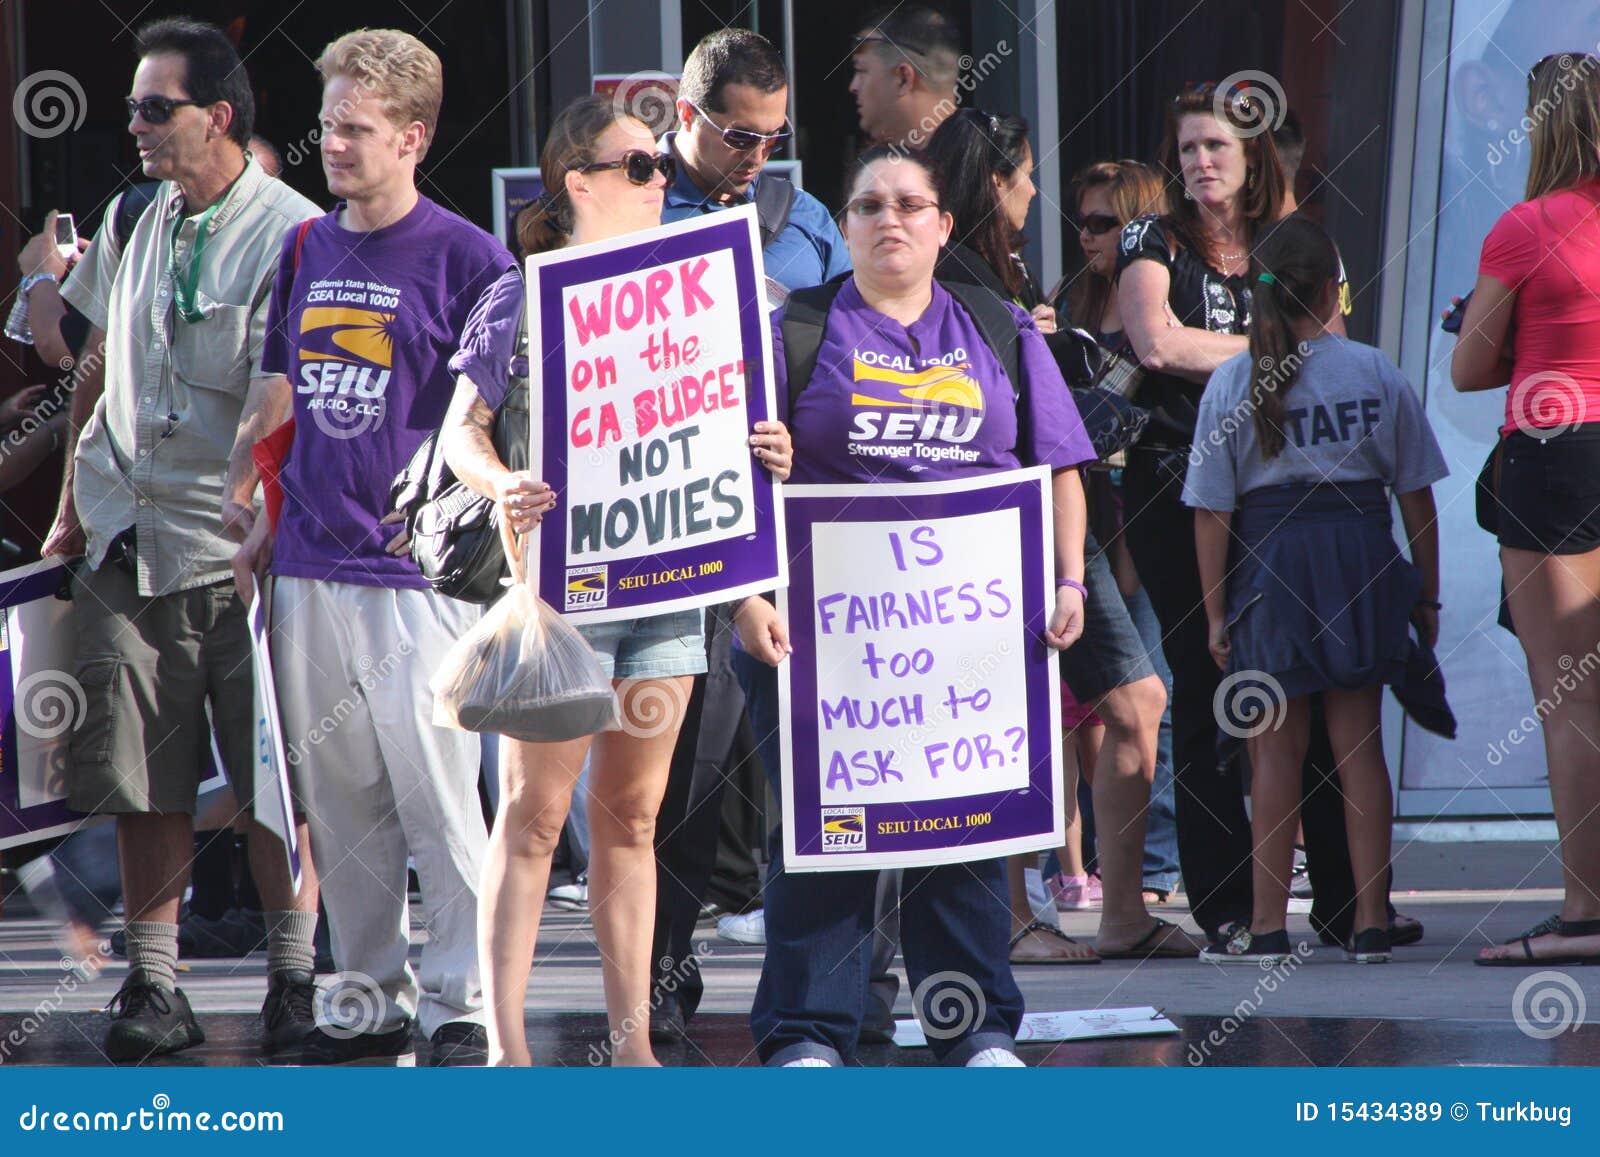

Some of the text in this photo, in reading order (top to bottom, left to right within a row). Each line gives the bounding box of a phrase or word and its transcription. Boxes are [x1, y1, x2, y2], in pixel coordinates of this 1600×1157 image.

[307, 290, 399, 308] CSEA Local 1000
[310, 280, 401, 296] California State Workers
[568, 257, 715, 347] WORK
[570, 327, 701, 393] on the
[853, 348, 915, 371] LOCAL
[297, 362, 392, 399] SEIU
[355, 403, 380, 417] CLC
[570, 359, 759, 449] CA BUDGET
[848, 411, 982, 443] SEIU
[1286, 398, 1381, 448] TAFF
[619, 425, 700, 486] NOT
[847, 442, 980, 462] Stronger Together
[570, 469, 744, 555] MOVIES
[888, 526, 943, 571] IS
[619, 560, 723, 590] SEIU LOCAL 1000
[567, 591, 605, 604] SEIU
[817, 578, 1011, 635] FAIRNESS
[862, 642, 934, 679] too
[821, 685, 991, 730] MUCH to
[825, 726, 1026, 792] ASK FOR?
[824, 833, 863, 846] SEIU
[878, 812, 992, 835] SEIU LOCAL 1000
